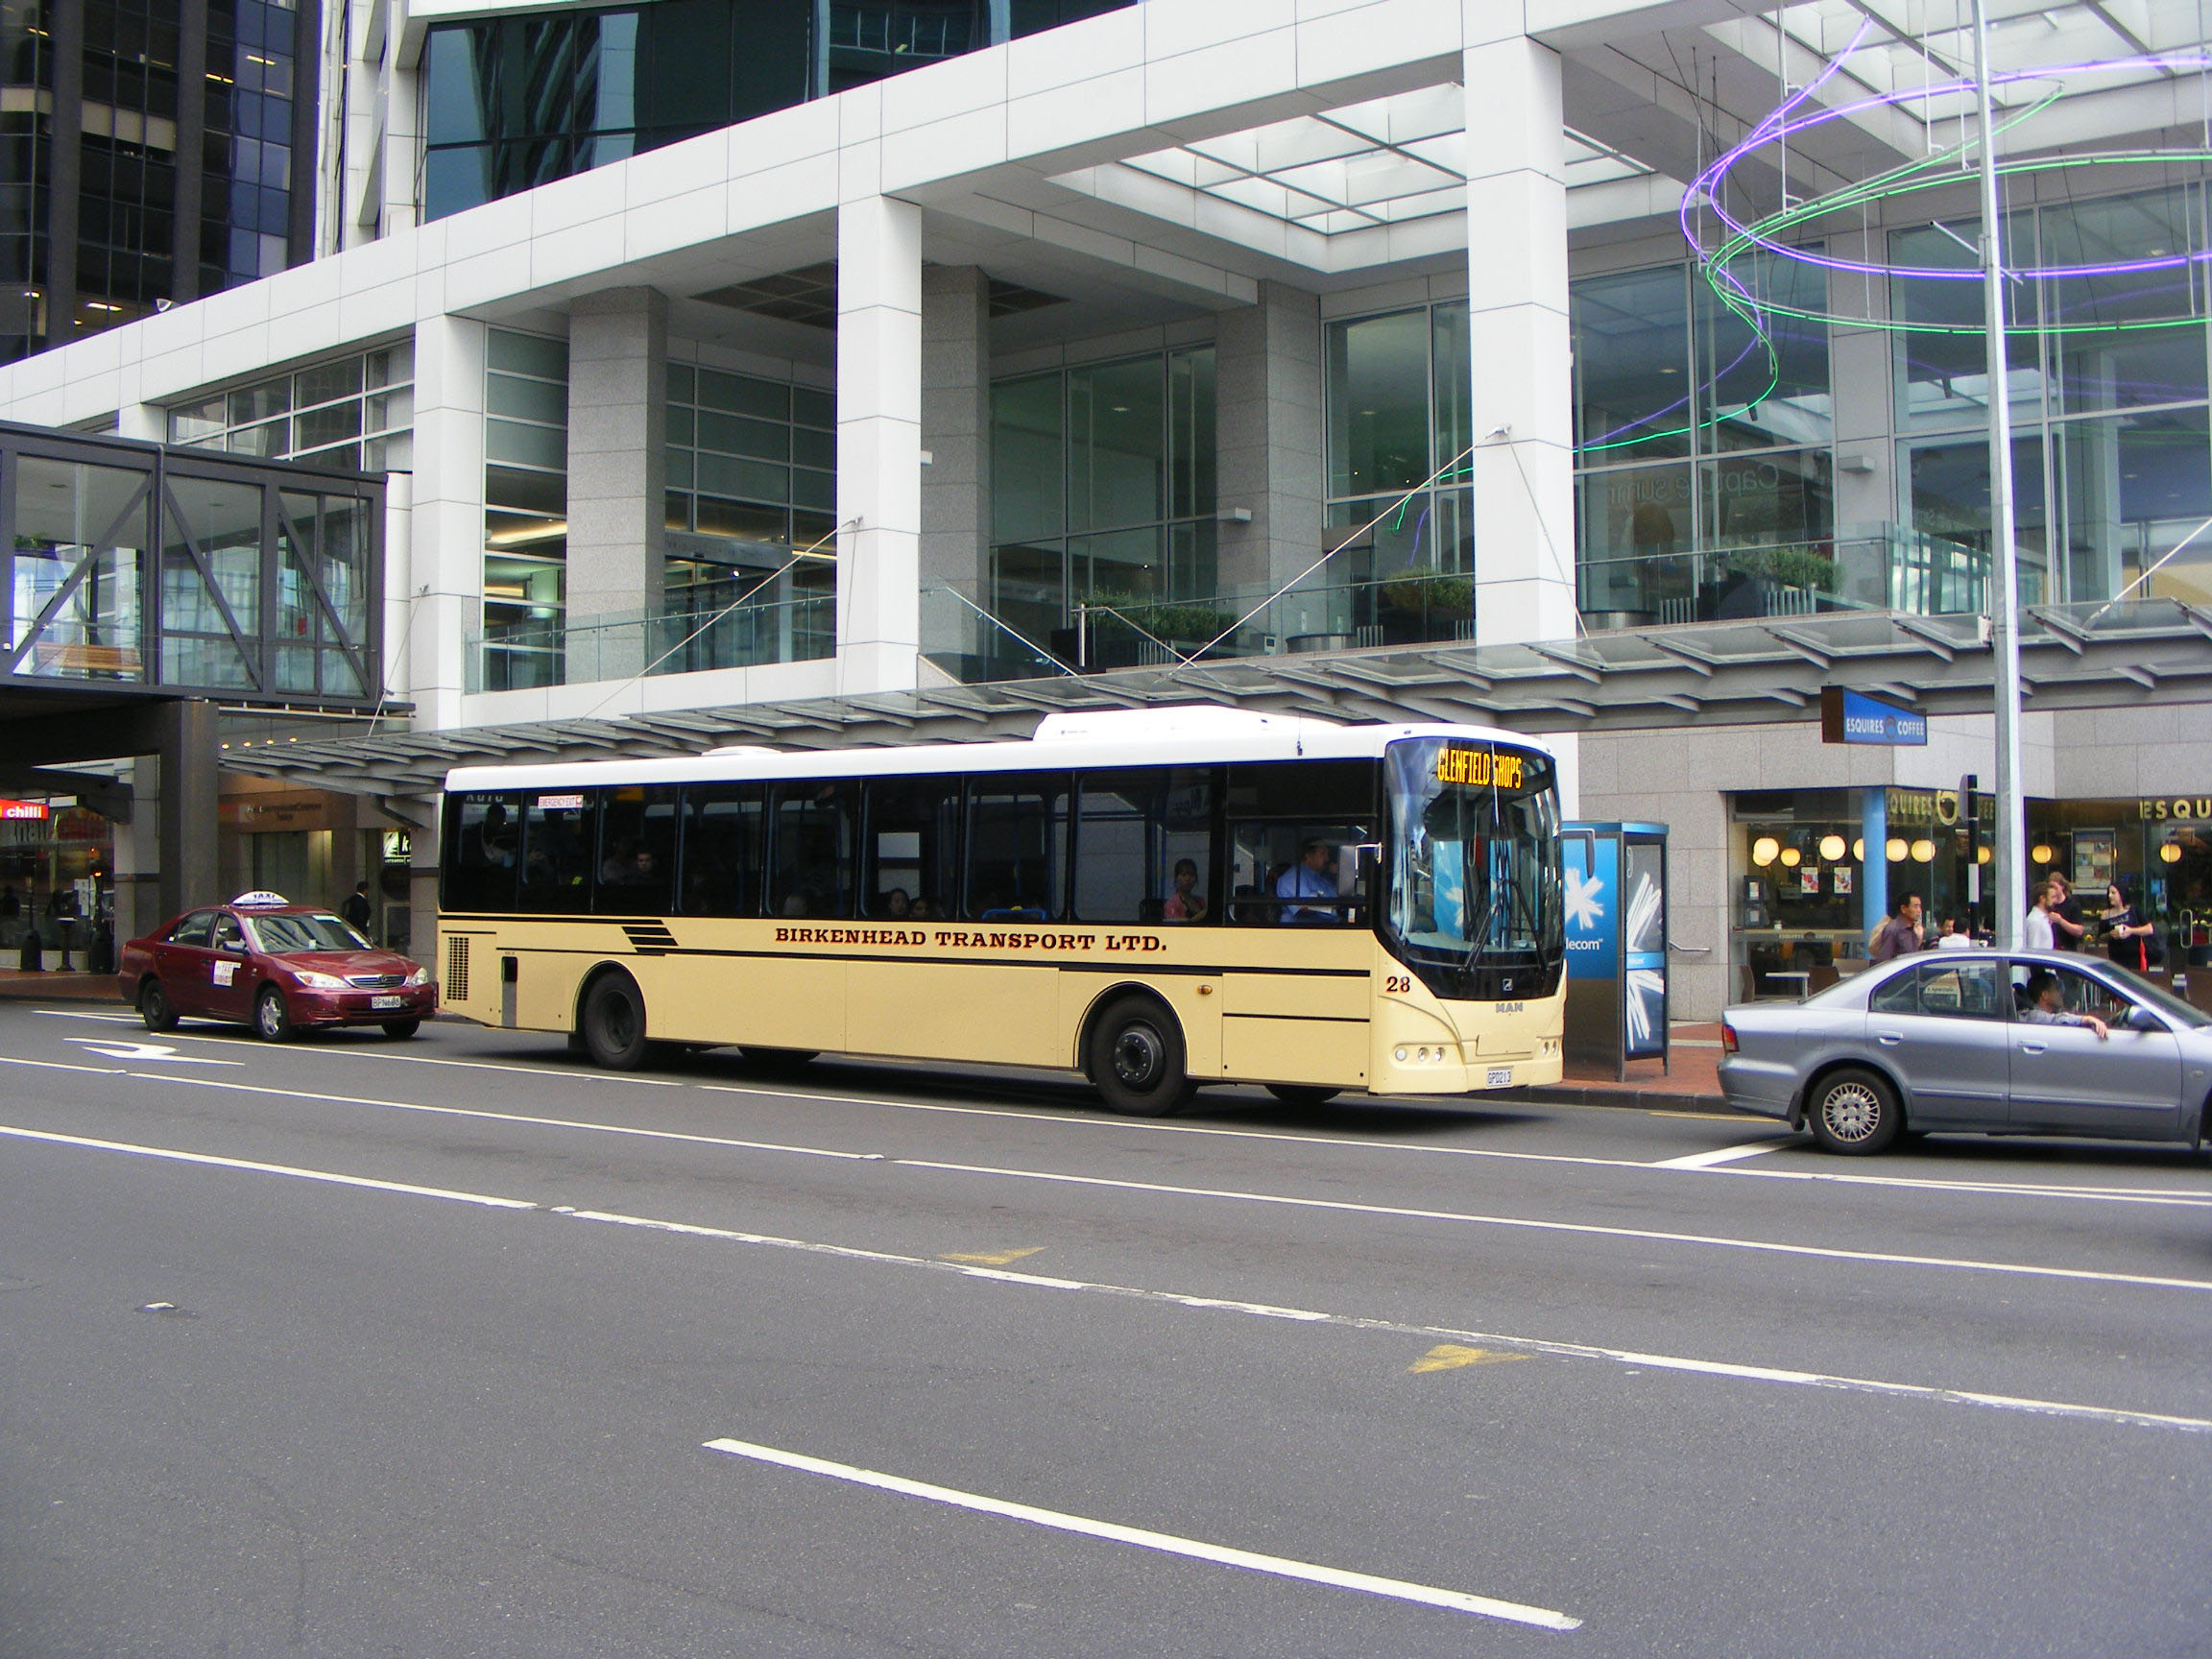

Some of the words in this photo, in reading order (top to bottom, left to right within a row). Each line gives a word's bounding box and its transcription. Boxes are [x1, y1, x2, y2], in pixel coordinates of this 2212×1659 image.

[1846, 717, 1885, 734] ESQUIRES
[1897, 720, 1925, 736] COFFEE
[1437, 749, 1490, 785] GLENFIELD
[1492, 755, 1522, 789] SHOPS
[539, 797, 566, 807] EMERGENCY
[566, 797, 576, 806] EXIT
[2139, 799, 2211, 820] ESQU
[6, 806, 42, 818] chilli
[776, 928, 926, 946] BIRKENHEAD
[935, 931, 1095, 950] TRANSPORT
[1105, 935, 1167, 951] LTD.
[1385, 976, 1410, 993] 28
[1496, 1001, 1524, 1013] MAN
